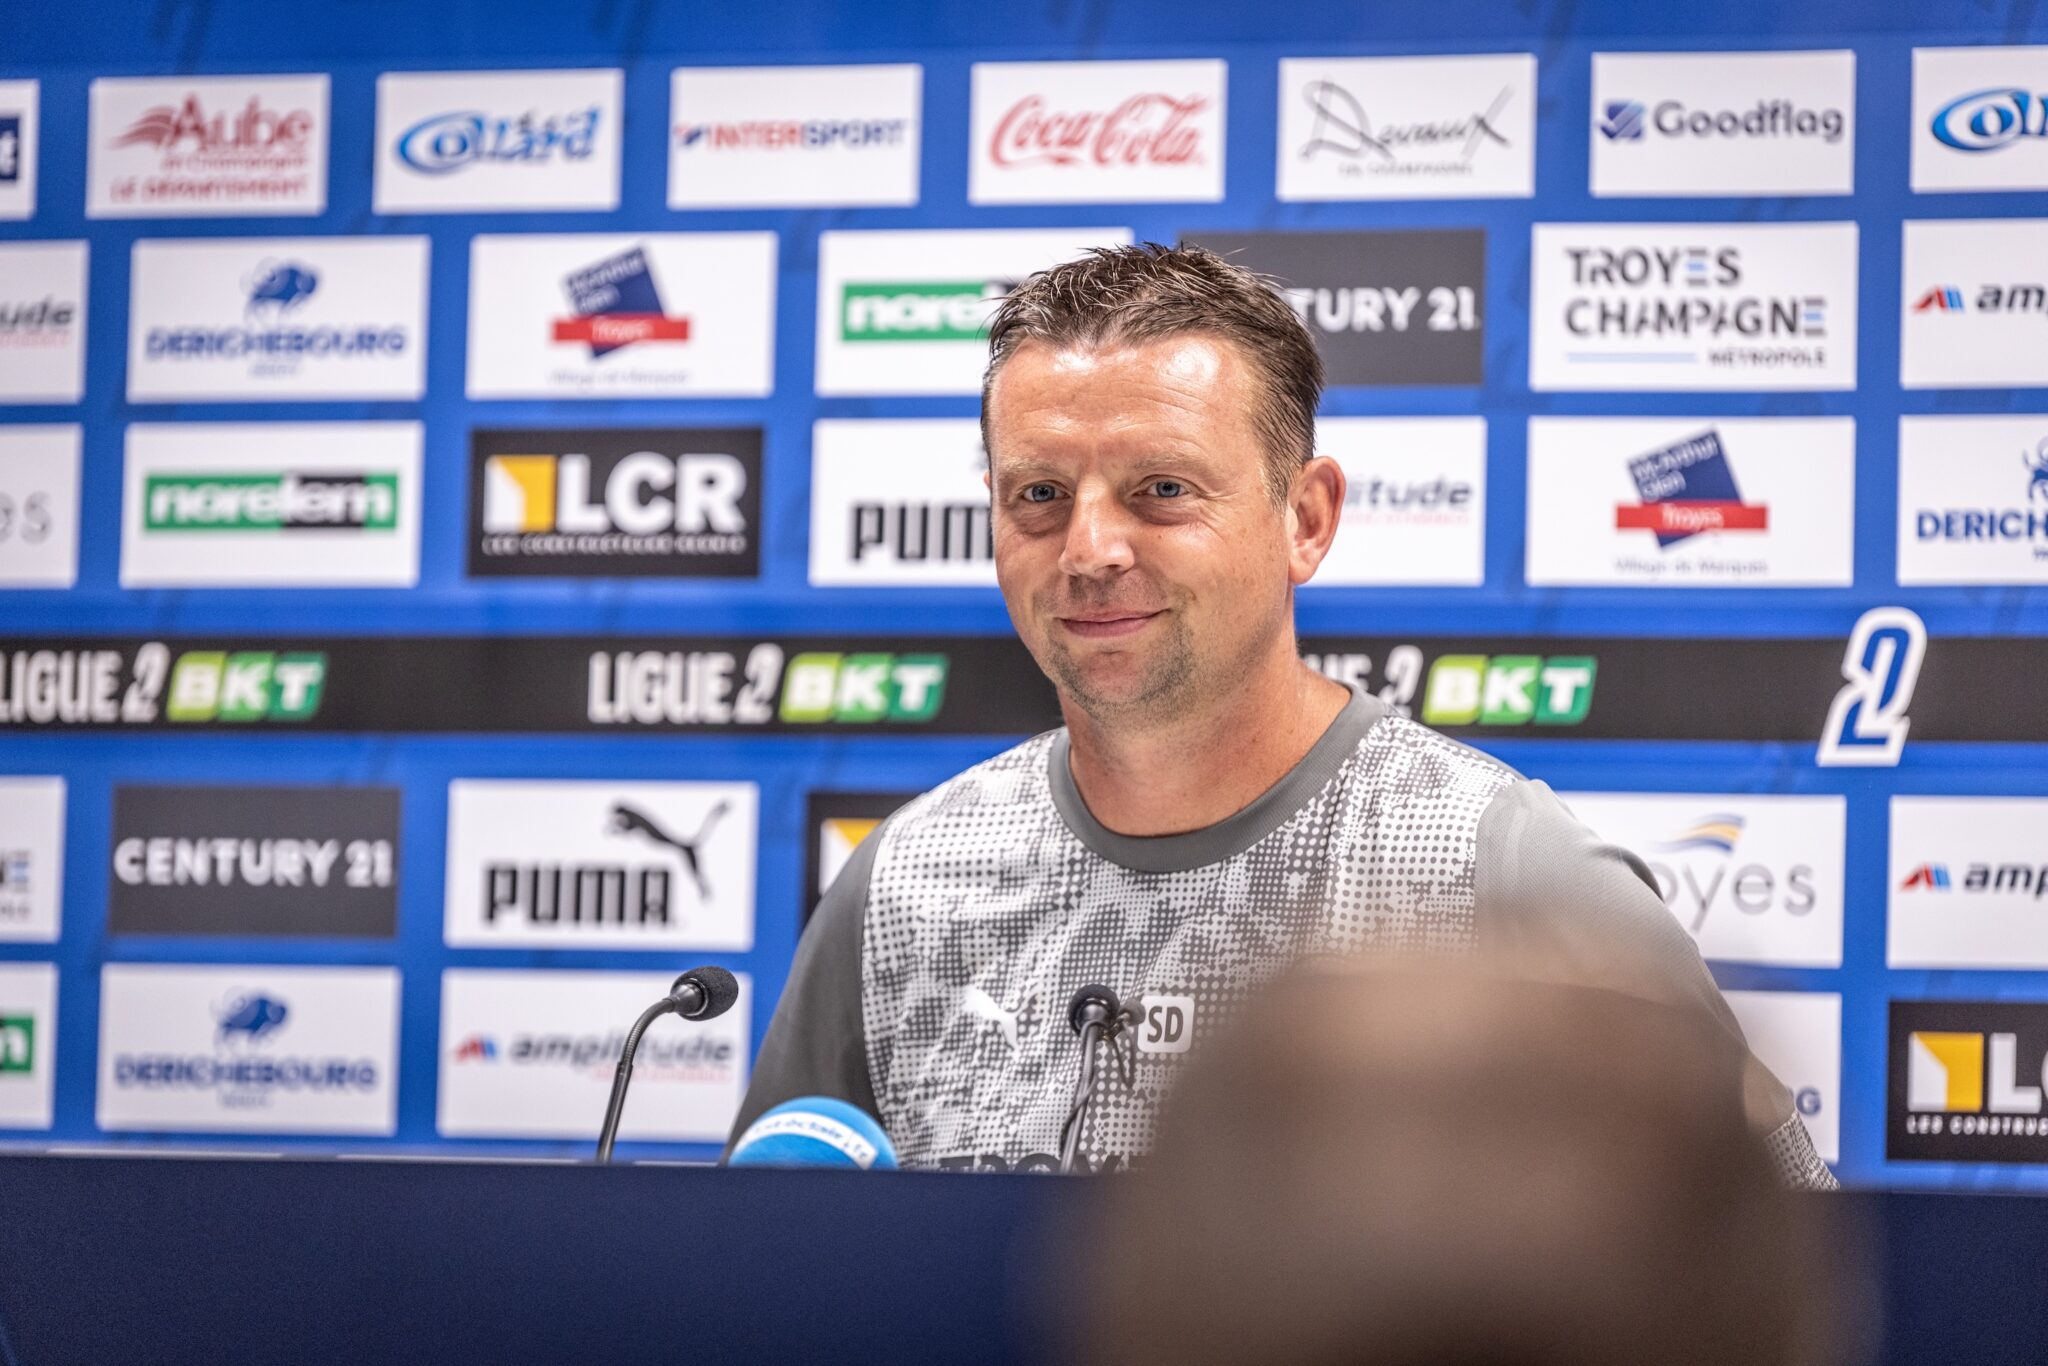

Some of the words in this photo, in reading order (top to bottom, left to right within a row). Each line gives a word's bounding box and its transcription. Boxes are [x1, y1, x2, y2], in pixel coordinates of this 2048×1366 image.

[166, 93, 314, 149] Aube
[396, 105, 601, 173] Collard
[709, 119, 904, 149] INTERSPORT
[1653, 100, 1844, 142] Goodflag
[1565, 247, 1742, 288] TROYES
[1427, 285, 1476, 331] 21
[1565, 298, 1827, 339] CHAMPAGNE
[1975, 284, 2048, 318] am
[145, 325, 407, 363] DERICHEBOURG
[149, 470, 393, 524] norelem
[556, 451, 747, 535] LCR
[173, 658, 323, 713] BKT
[588, 651, 736, 724] LIGUE
[732, 643, 784, 724] 2
[784, 658, 947, 717] BKT
[1427, 661, 1593, 719] BKT
[114, 837, 341, 887] CENTURY
[344, 839, 394, 887] 21
[484, 864, 672, 925] PUMA
[1146, 1006, 1184, 1043] SD
[508, 1027, 733, 1072] ampliude
[113, 1055, 378, 1093] DERICHEBOURG
